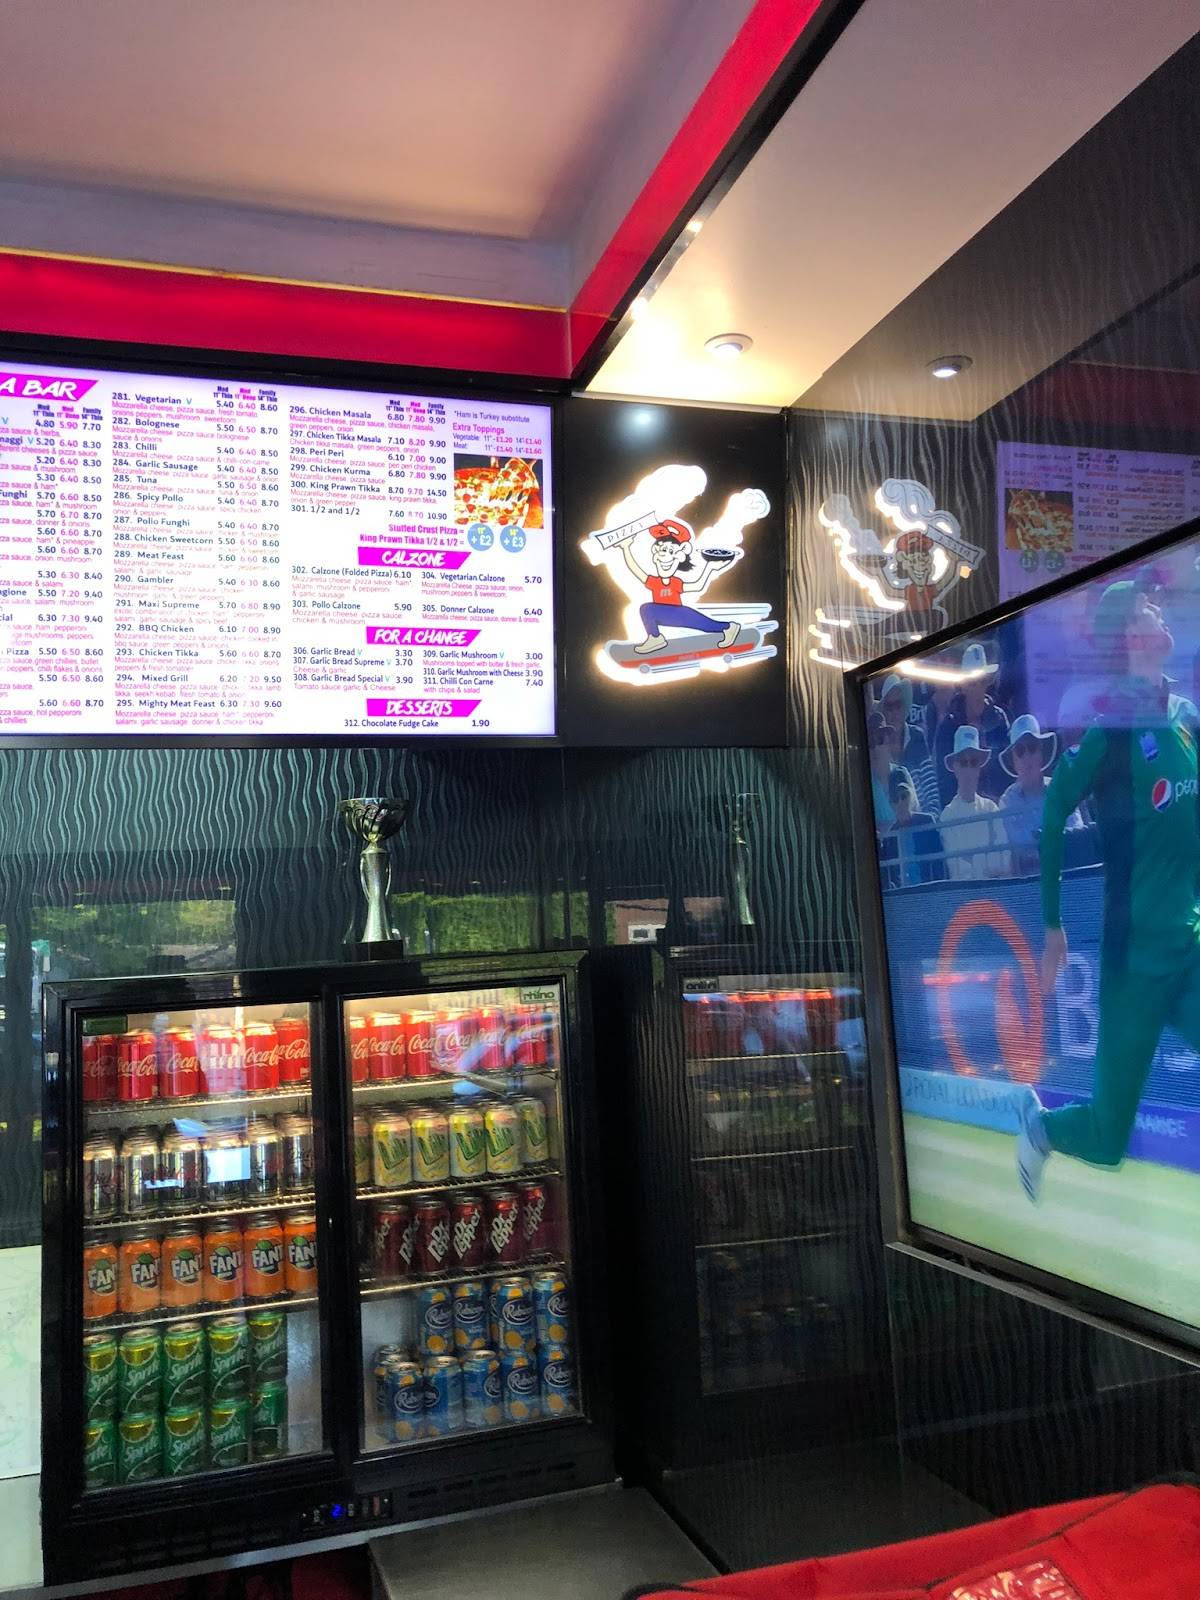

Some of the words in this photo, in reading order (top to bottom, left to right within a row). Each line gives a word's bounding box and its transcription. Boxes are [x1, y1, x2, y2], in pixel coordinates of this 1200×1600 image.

[0, 378, 16, 394] A
[22, 380, 79, 401] BAR
[112, 392, 131, 401] 281.
[135, 394, 181, 404] Vegetarian
[309, 407, 341, 416] Chicken
[343, 410, 371, 418] Masala
[60, 421, 78, 429] 5.90
[83, 423, 101, 431] 7.70
[112, 417, 131, 425] 282.
[136, 419, 179, 428] Bolognese
[453, 423, 471, 431] Extra
[473, 424, 504, 434] Toppings
[307, 431, 334, 439] Chicken
[337, 433, 355, 441] Tikka
[357, 435, 381, 443] Masala
[310, 448, 325, 456] Peri
[430, 456, 446, 464] 9.00
[136, 460, 160, 468] Garlic
[163, 462, 198, 471] Sausage
[310, 482, 329, 490] King
[427, 489, 447, 497] 14.50
[388, 524, 416, 533] Stuffed
[418, 525, 438, 534] Crust
[439, 526, 458, 535] Pizza
[135, 534, 167, 543] Chicken
[170, 536, 213, 544] Sweetcorn
[360, 534, 377, 543] King
[379, 535, 402, 543] Prawn
[405, 536, 424, 544] Tikka
[426, 537, 438, 545] 1/2
[447, 538, 458, 546] 1/2
[480, 535, 491, 546] £2
[512, 537, 524, 547] £3
[381, 551, 446, 567] CALZONE
[292, 566, 308, 574] 302.
[311, 567, 340, 575] Calzone
[342, 568, 369, 576] (Folded
[371, 570, 392, 578] Pizza)
[422, 571, 436, 579] 304.
[441, 572, 478, 582] Vegetarian
[479, 574, 505, 582] Calzone
[374, 629, 400, 643] FOR
[402, 630, 411, 643] A
[414, 631, 468, 645] CHANGE
[62, 648, 80, 656] 6.50
[525, 652, 543, 660] 3.00
[139, 700, 168, 709] Mighty
[385, 701, 453, 716] DESSERTS
[362, 719, 397, 727] Chocolate
[399, 720, 420, 728] Fudge
[524, 988, 555, 1000] rhino
